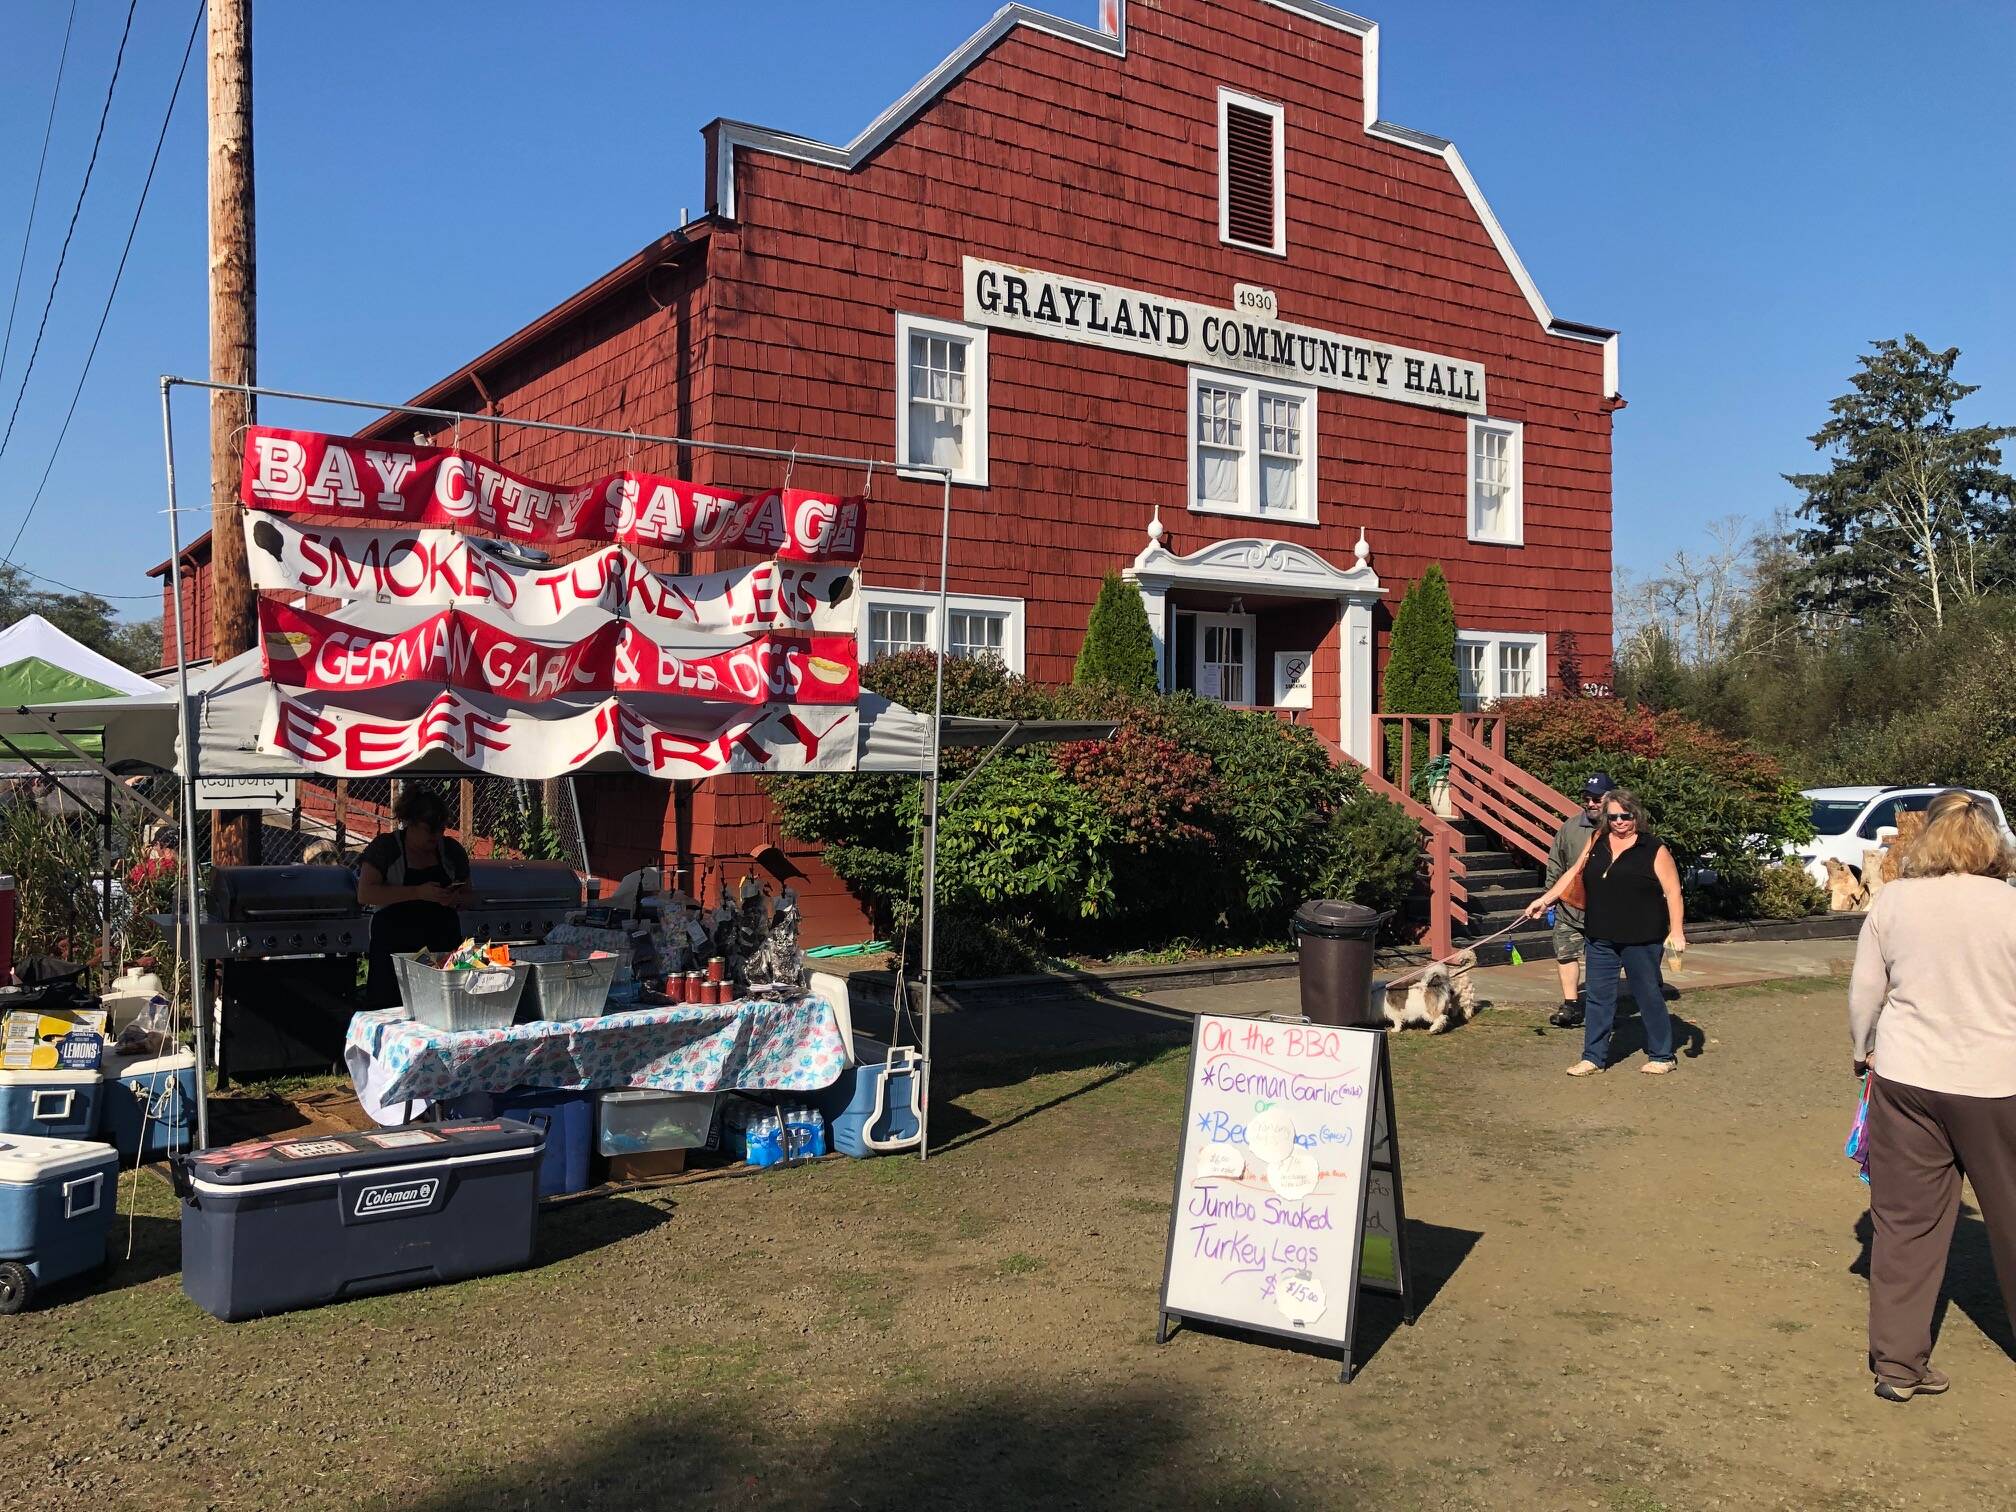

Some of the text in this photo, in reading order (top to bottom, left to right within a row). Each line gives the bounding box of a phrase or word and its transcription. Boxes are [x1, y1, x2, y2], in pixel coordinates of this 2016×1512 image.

[1239, 290, 1272, 311] 1930
[976, 269, 1480, 403] GRAYLAND COMMUNITY HALL
[252, 436, 859, 554] BAY CITY SAUSAGE
[299, 533, 817, 626] SMOKED TURKEY LEGS
[315, 617, 478, 686] GERMAN
[613, 627, 640, 684] &
[273, 694, 850, 771] BEEF JERKY
[64, 1043, 97, 1058] LEMONS
[1203, 1021, 1341, 1062] On the BBQ
[1291, 1074, 1342, 1105] Garlic
[365, 1189, 418, 1207] Coleman
[1189, 1185, 1256, 1221] Jumbo
[1263, 1197, 1332, 1230] Smoked
[1190, 1223, 1319, 1272] Turkey Legs
